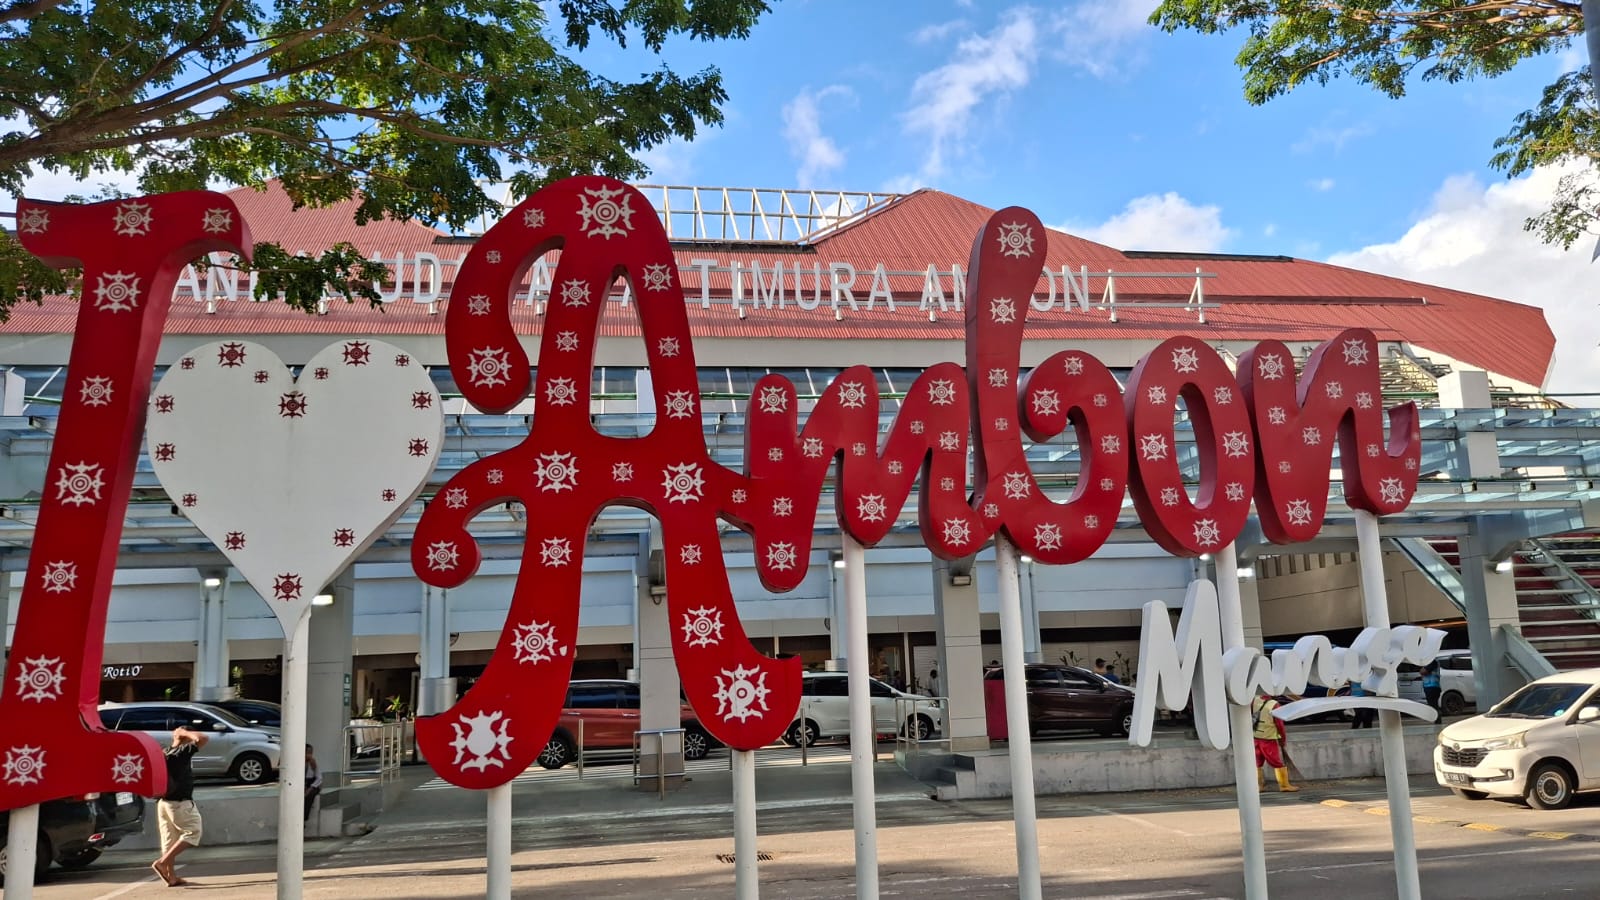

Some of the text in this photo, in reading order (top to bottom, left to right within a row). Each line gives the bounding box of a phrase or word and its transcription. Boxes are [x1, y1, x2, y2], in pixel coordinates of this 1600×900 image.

[918, 262, 1089, 313] AON
[0, 174, 1421, 810] I Ambon
[1128, 578, 1448, 750] Manise
